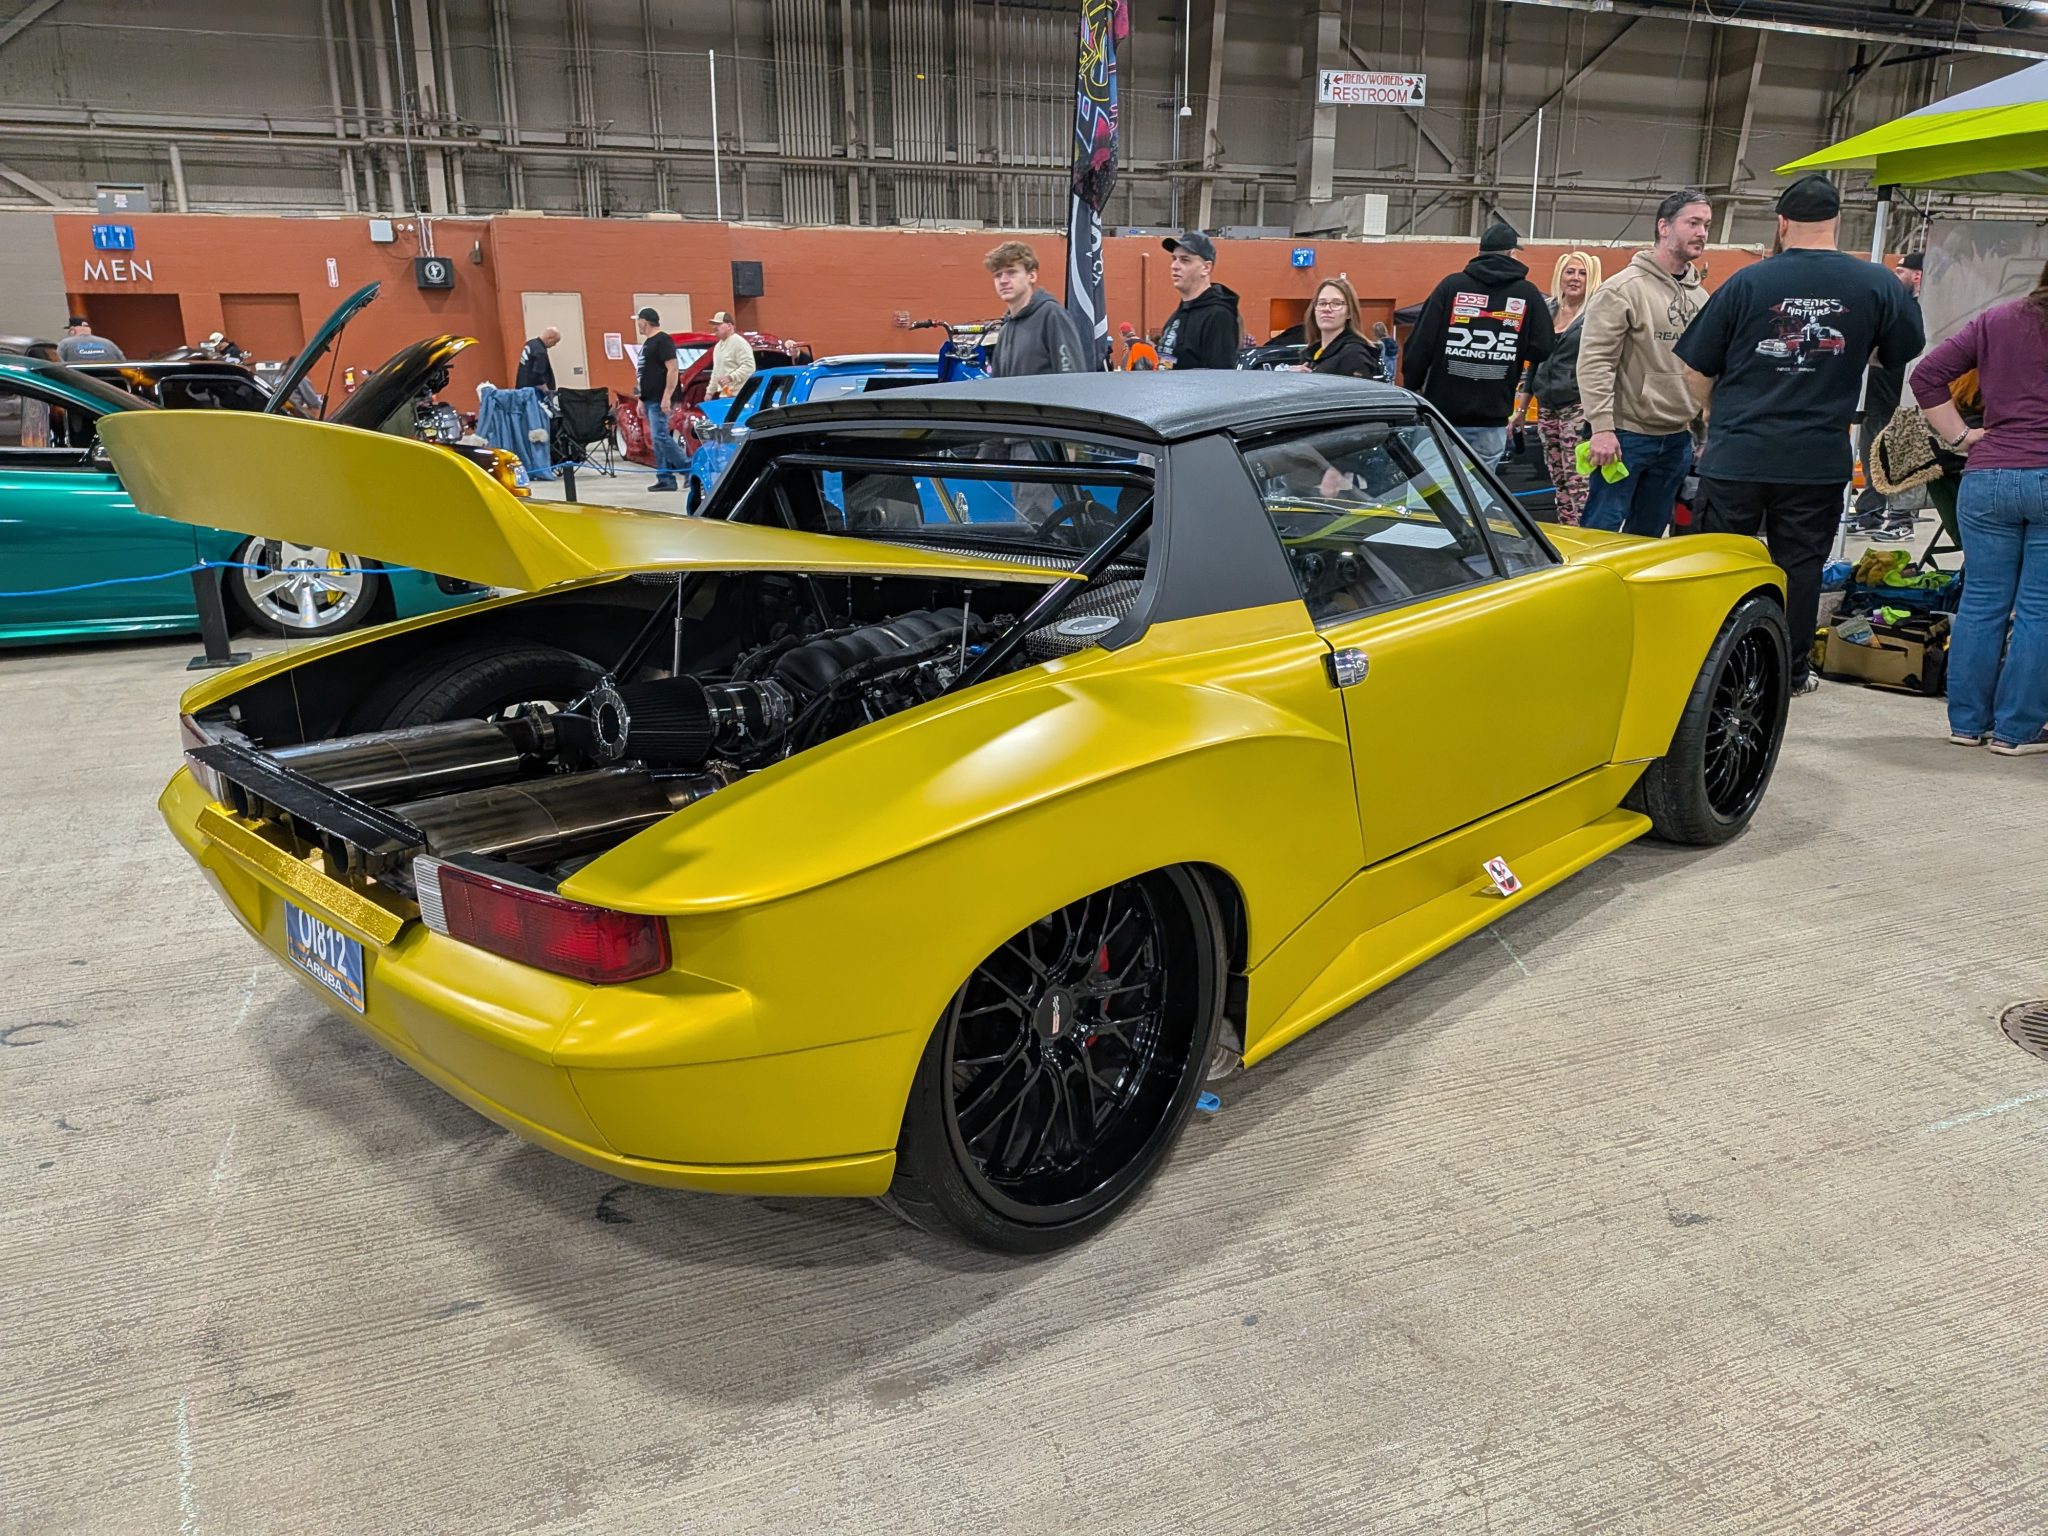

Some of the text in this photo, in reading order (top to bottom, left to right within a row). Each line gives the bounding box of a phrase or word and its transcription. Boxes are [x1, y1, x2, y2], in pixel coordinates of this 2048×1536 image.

[1343, 73, 1404, 86] MENS/WOMENS
[1332, 86, 1408, 103] RESTROOM
[83, 258, 153, 281] MEN
[1654, 331, 1684, 341] REA
[1445, 347, 1517, 361] RACING TEAM
[306, 957, 343, 993] ARUBA
